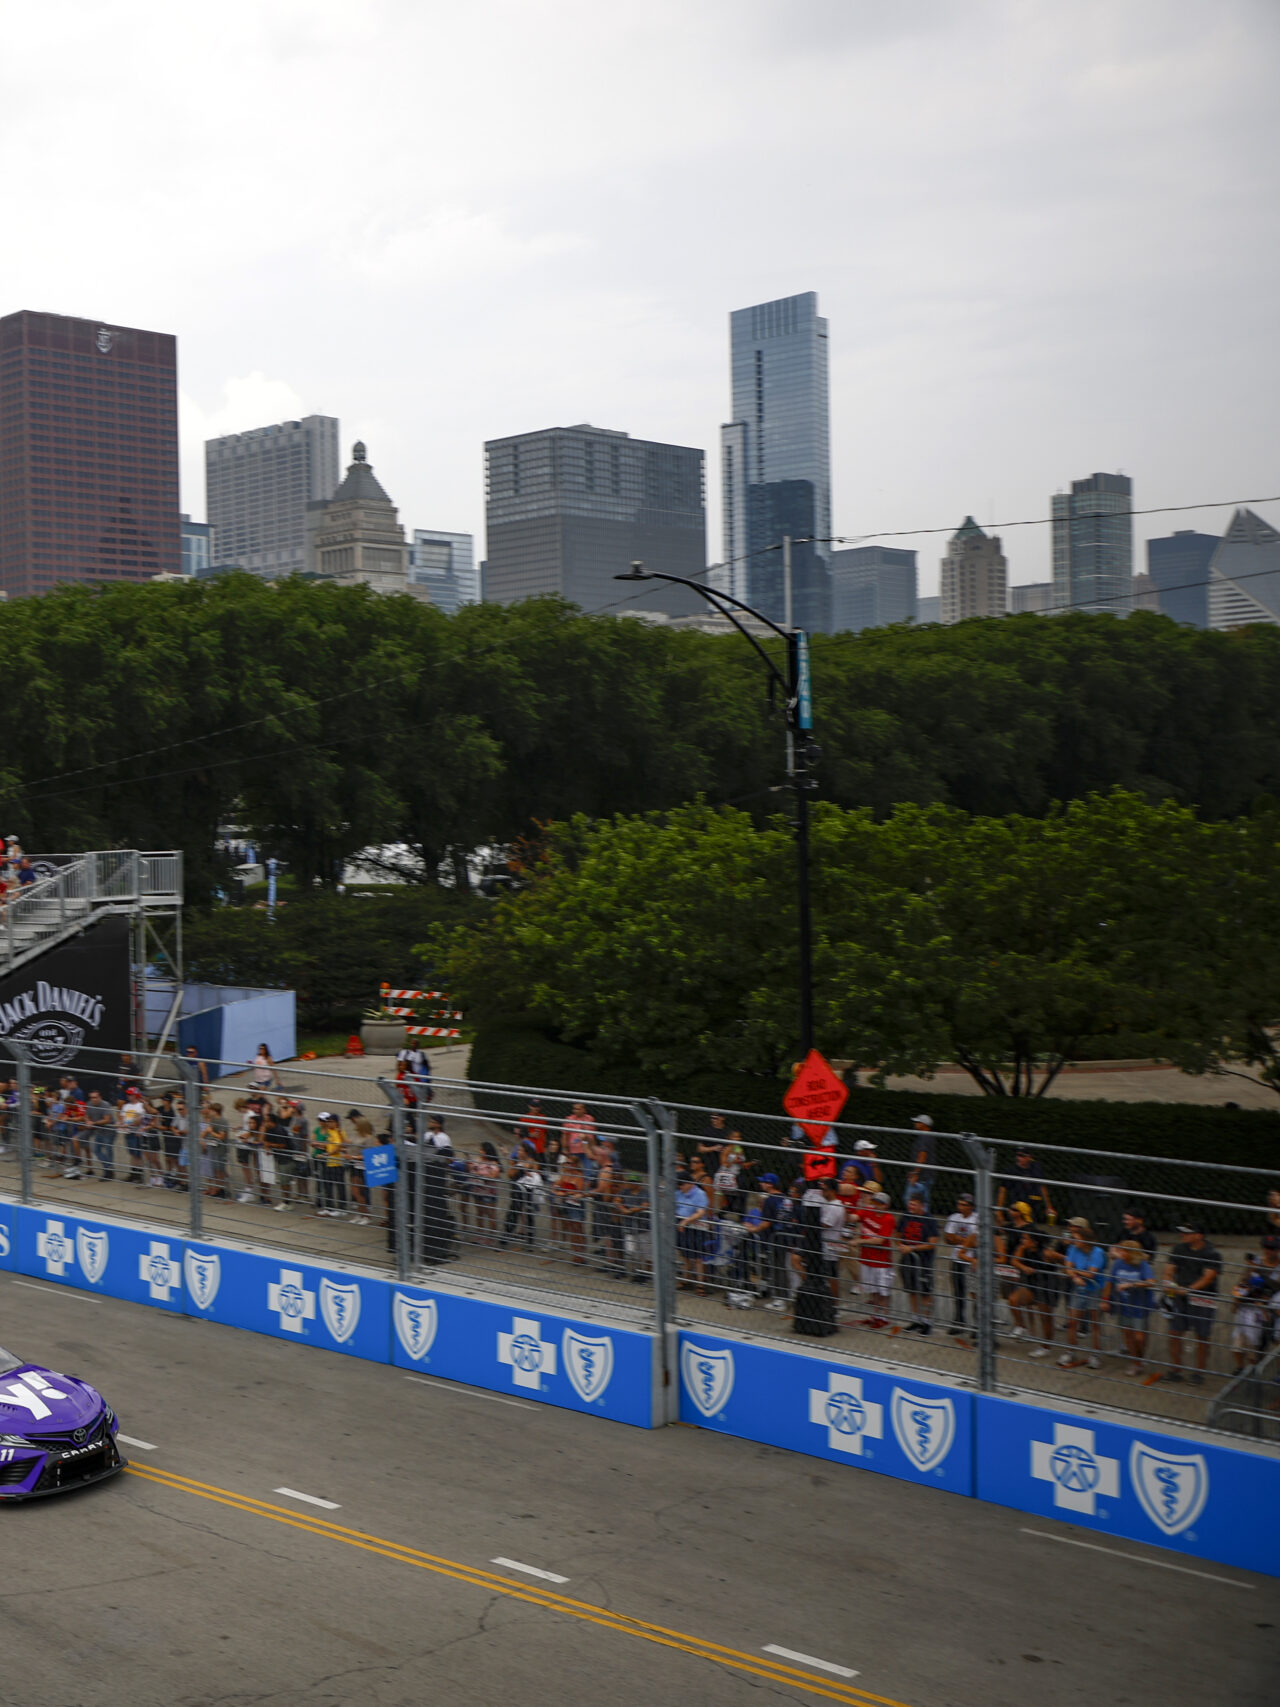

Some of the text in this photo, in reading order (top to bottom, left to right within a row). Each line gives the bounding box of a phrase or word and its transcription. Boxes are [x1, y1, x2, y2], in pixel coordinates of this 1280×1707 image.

[36, 981, 106, 1030] DANIEL'S
[0, 1448, 15, 1462] 11
[61, 1441, 103, 1458] CAMRY
